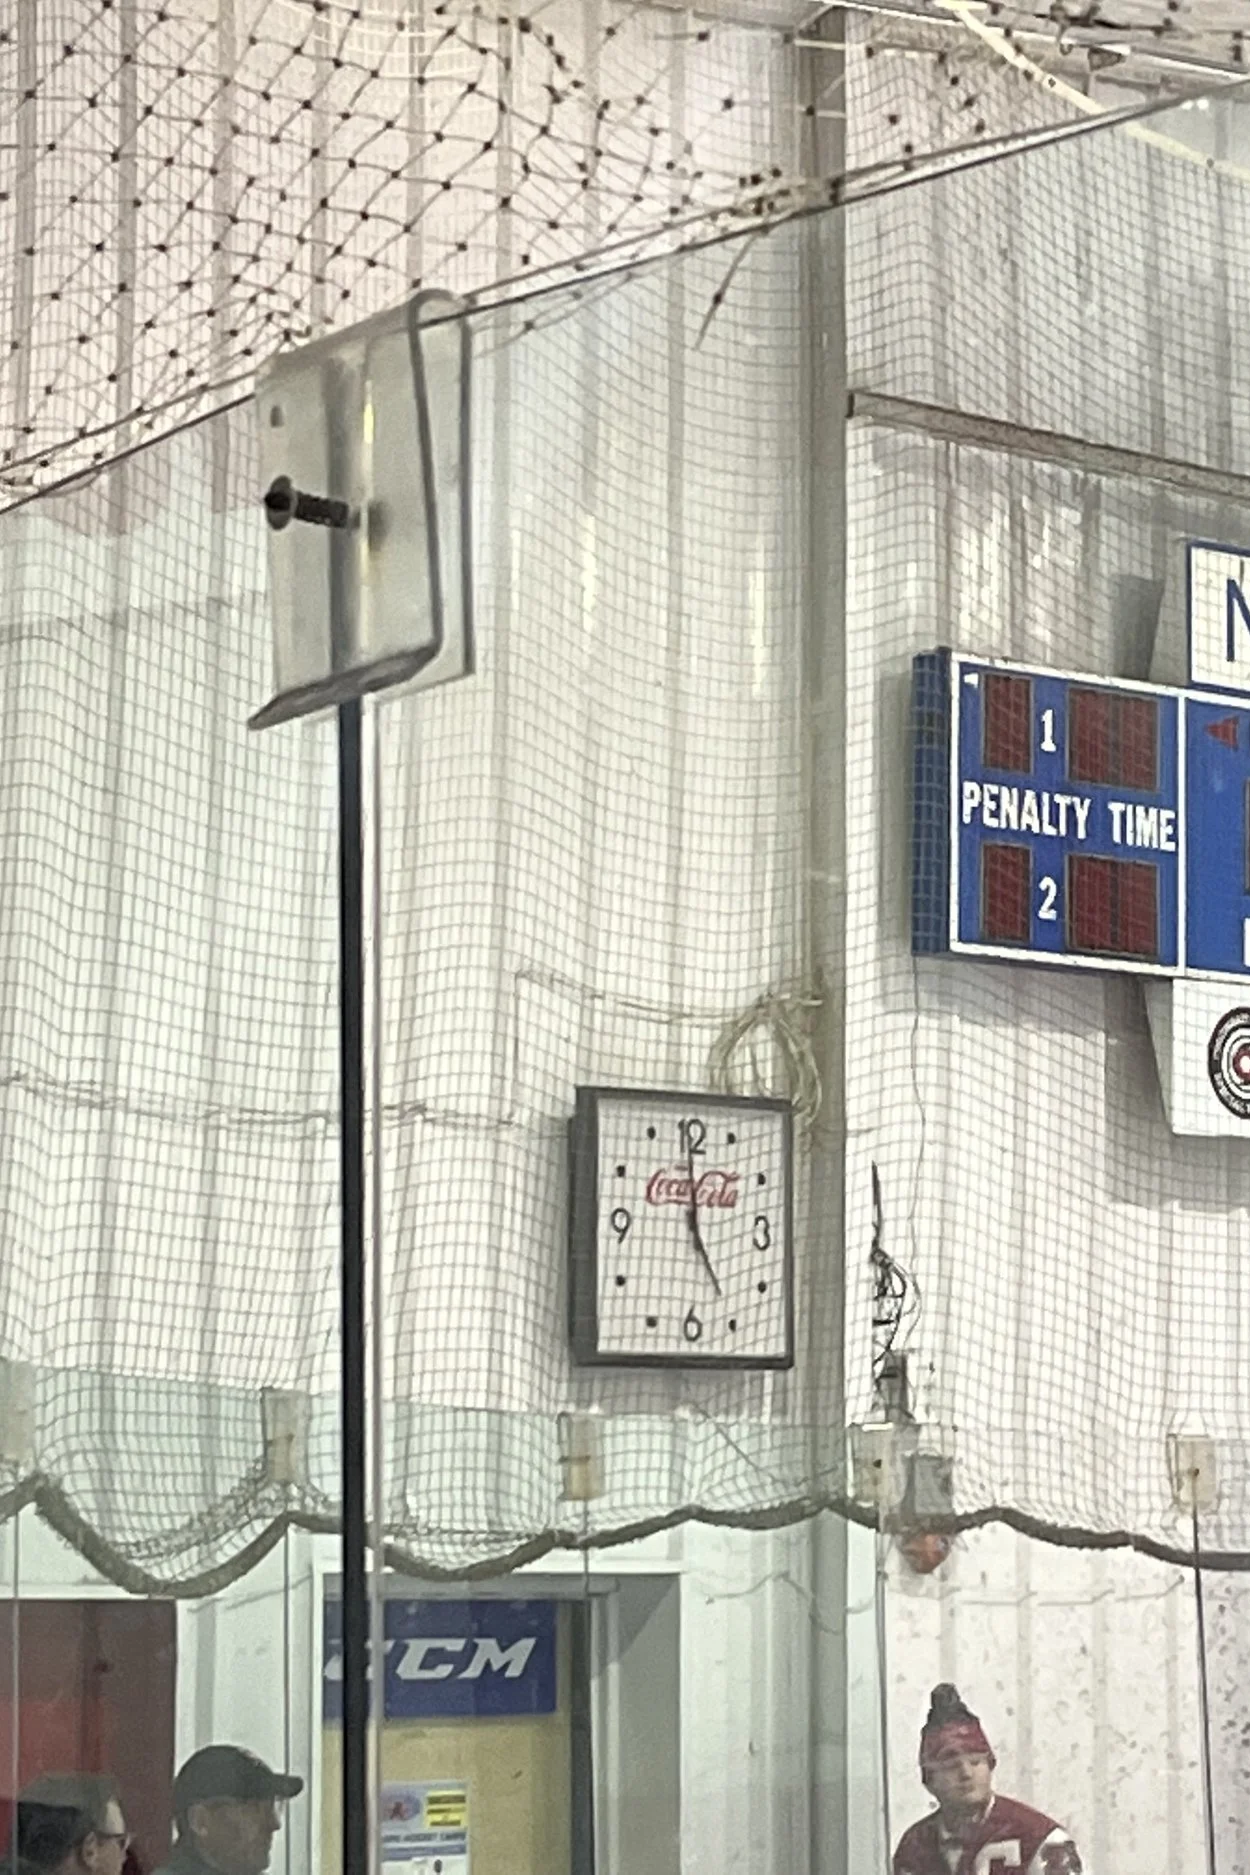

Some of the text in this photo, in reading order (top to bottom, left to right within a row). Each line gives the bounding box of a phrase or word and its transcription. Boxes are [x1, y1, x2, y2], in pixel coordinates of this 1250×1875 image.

[1040, 709, 1057, 752] 1
[962, 781, 1176, 852] PENALTY TIME
[1037, 876, 1057, 920] 2
[678, 1118, 706, 1155] 12
[611, 1207, 631, 1244] 9
[752, 1215, 771, 1251] 3
[684, 1304, 702, 1342] 6
